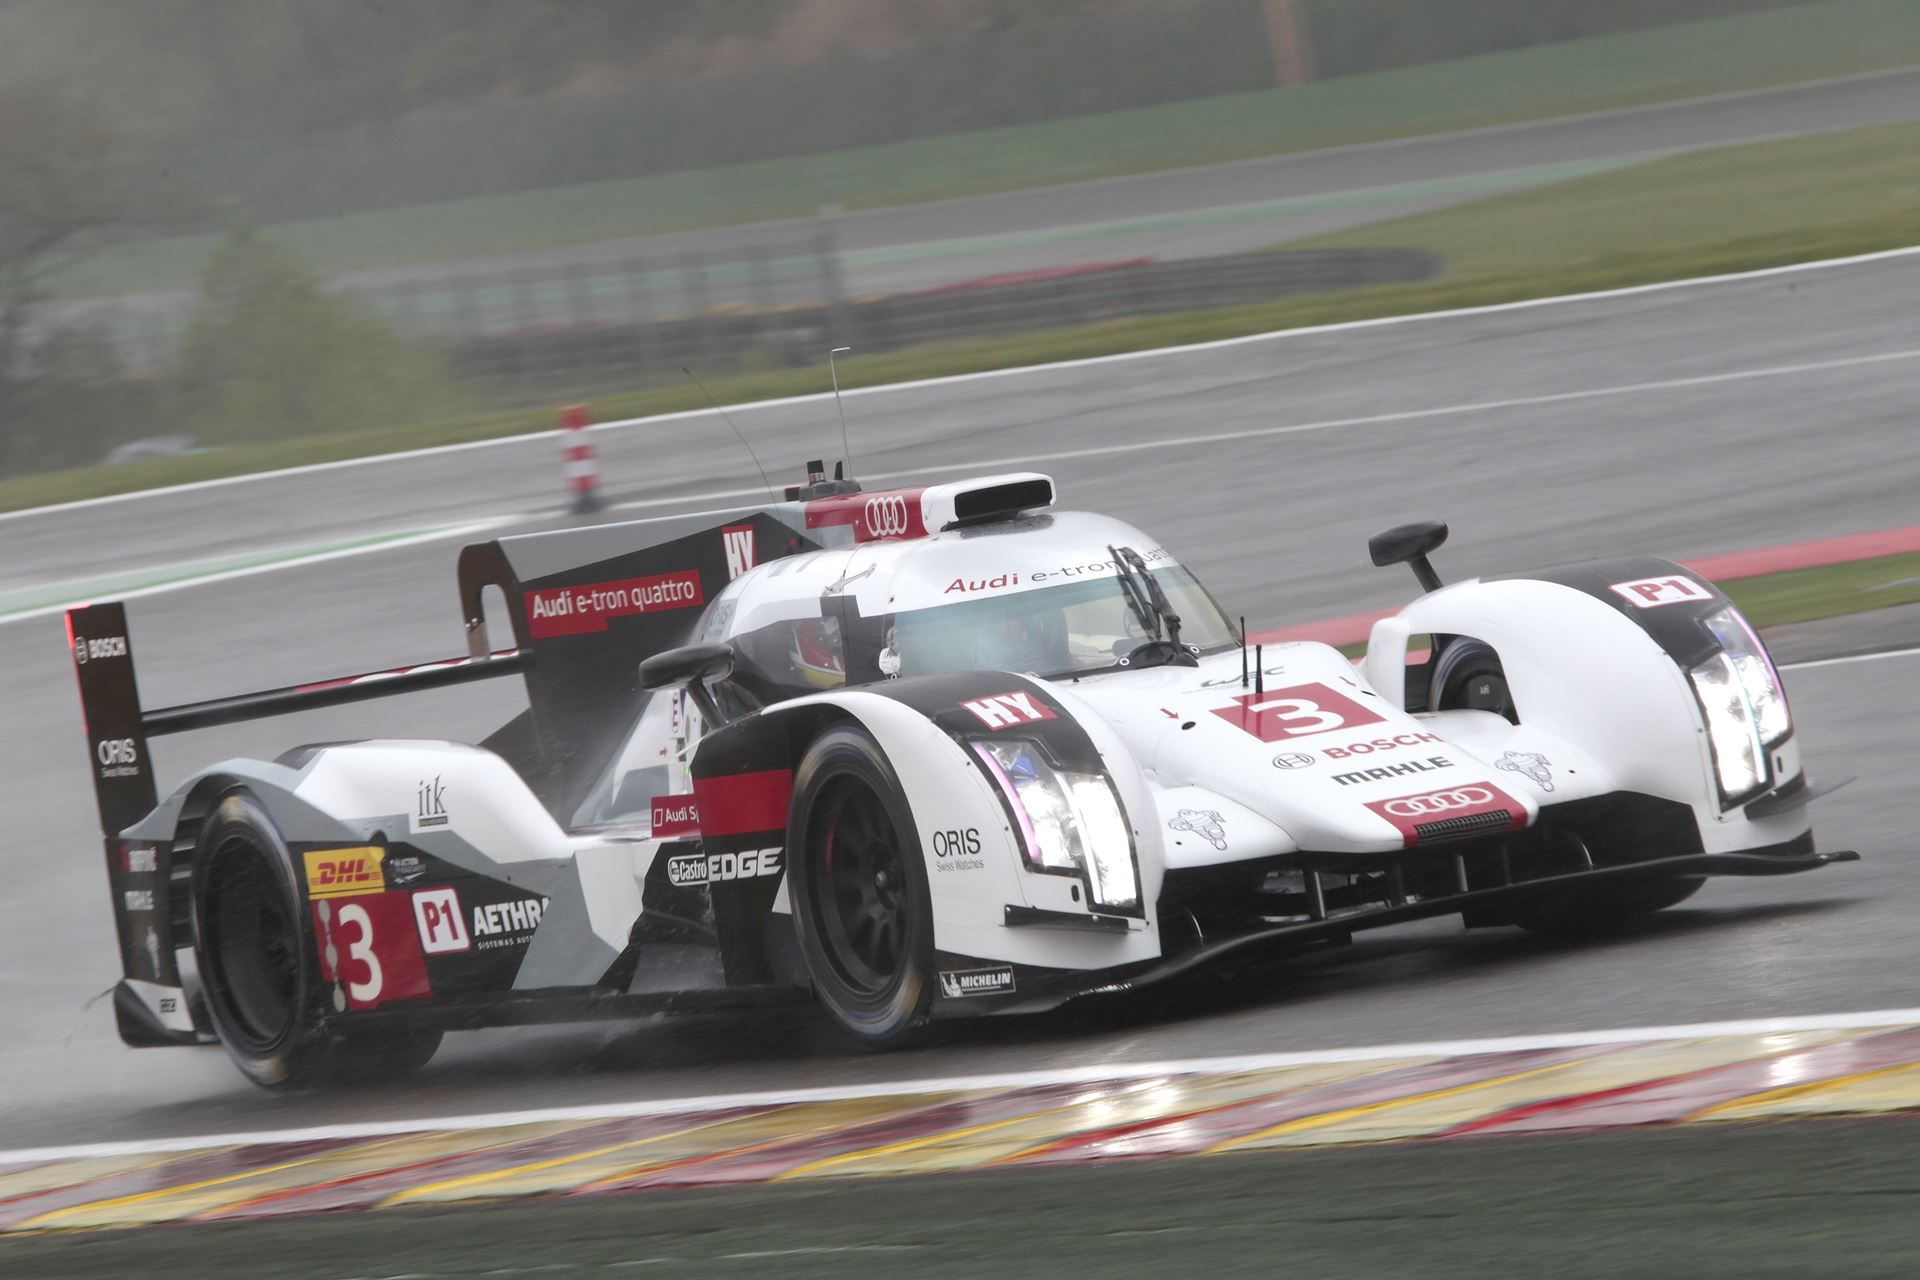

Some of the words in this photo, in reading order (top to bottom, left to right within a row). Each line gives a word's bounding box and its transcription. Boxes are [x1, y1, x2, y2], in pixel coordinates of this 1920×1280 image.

[723, 531, 753, 580] HY
[944, 572, 1020, 594] Audi
[1031, 560, 1121, 582] e-tron
[1629, 579, 1697, 601] P1
[533, 590, 574, 618] Audi
[576, 588, 629, 612] e-tron
[631, 580, 695, 610] quattro
[88, 636, 128, 659] BOSCH
[964, 692, 1043, 730] HY
[1249, 699, 1344, 735] 3
[97, 738, 137, 765] ORIS
[1321, 732, 1446, 760] BOSCH
[1330, 756, 1455, 786] MAHLE
[417, 774, 447, 816] itk
[665, 807, 688, 822] Audi
[933, 828, 981, 858] ORIS
[318, 859, 371, 885] DHL
[680, 859, 708, 881] Castro
[708, 846, 784, 882] EDGE
[421, 899, 460, 944] P1
[338, 903, 383, 1002] 3
[960, 972, 1011, 988] MICHELIN
